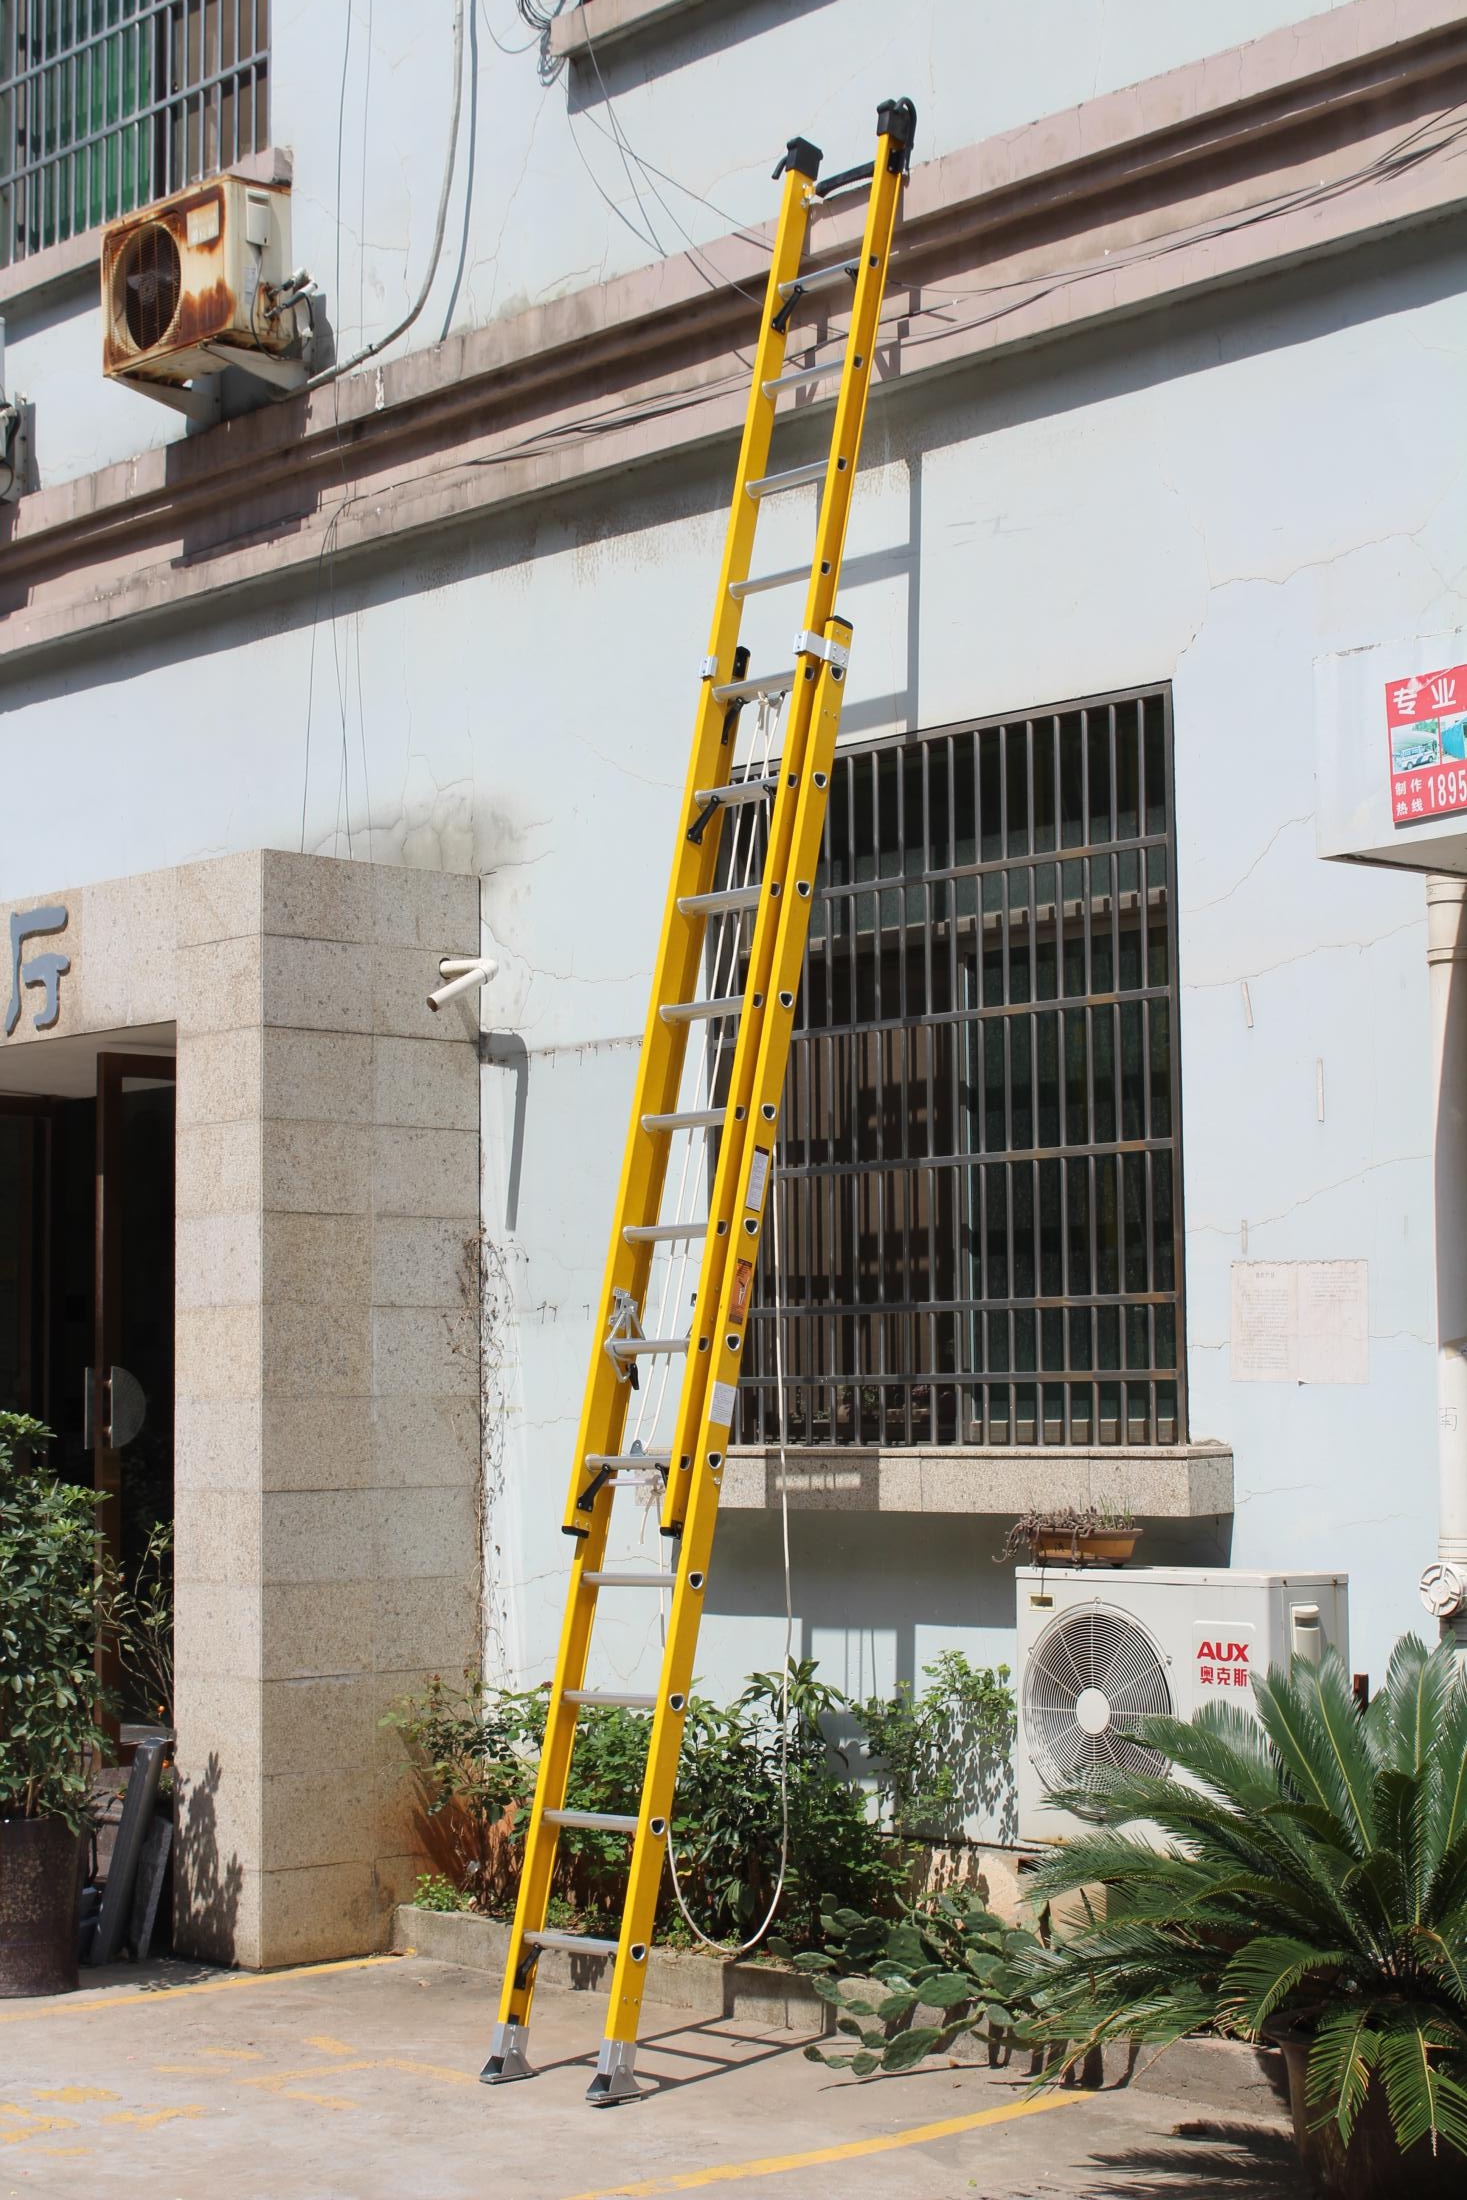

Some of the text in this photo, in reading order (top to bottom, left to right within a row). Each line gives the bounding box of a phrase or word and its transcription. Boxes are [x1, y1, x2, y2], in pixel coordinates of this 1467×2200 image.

[1392, 677, 1457, 715] 专业
[1394, 777, 1423, 797] 制作
[1427, 769, 1467, 808] 1895
[1396, 798, 1424, 817] 热线
[5, 905, 71, 1037] 厅
[1196, 1641, 1249, 1663] AUX
[1199, 1666, 1248, 1687] 奥克斯
